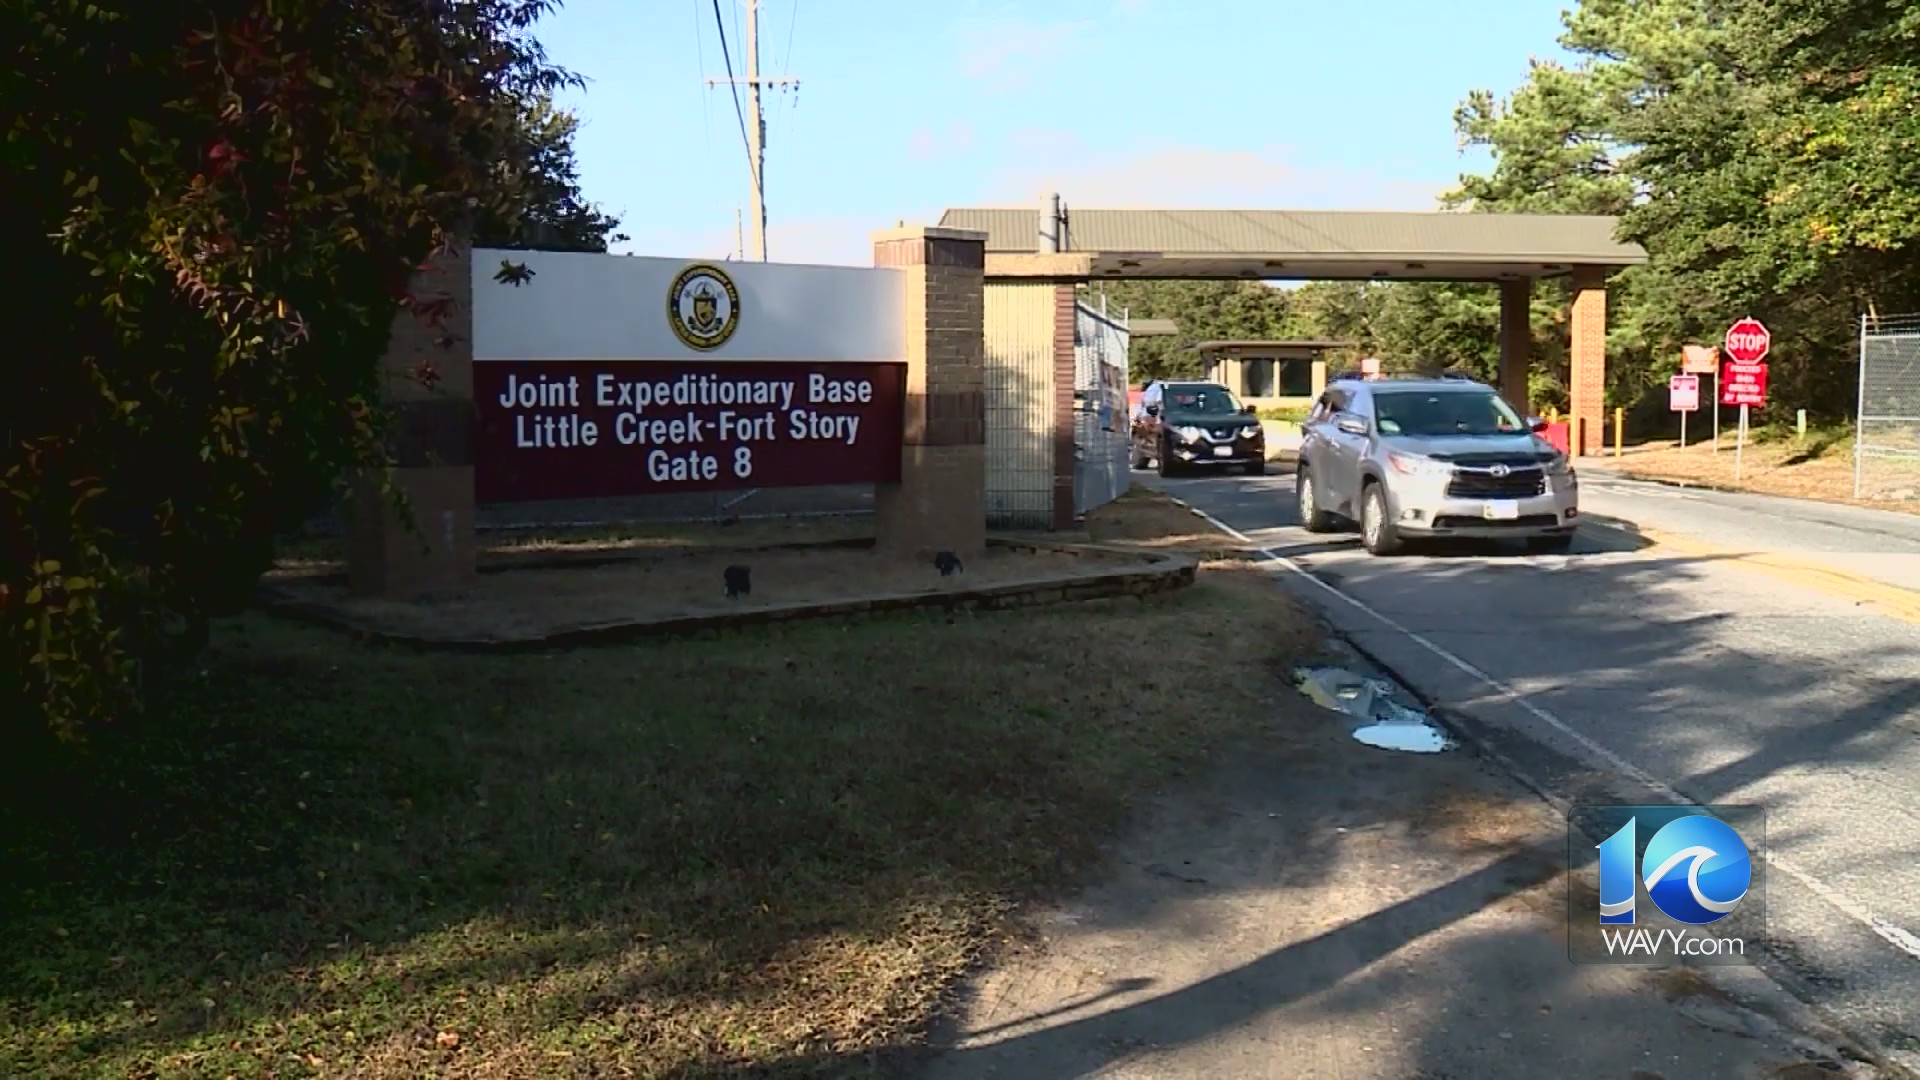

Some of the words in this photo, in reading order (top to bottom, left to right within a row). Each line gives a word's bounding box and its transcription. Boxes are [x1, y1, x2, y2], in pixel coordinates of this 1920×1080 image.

[1729, 333, 1766, 351] STOP
[500, 374, 579, 408] Joint
[597, 373, 795, 413] Expeditionary
[808, 373, 873, 403] Base
[516, 413, 598, 448] Little
[615, 410, 776, 446] Creek-Fort
[789, 409, 860, 444] Story
[647, 449, 718, 482] Gate
[733, 446, 752, 479] 8
